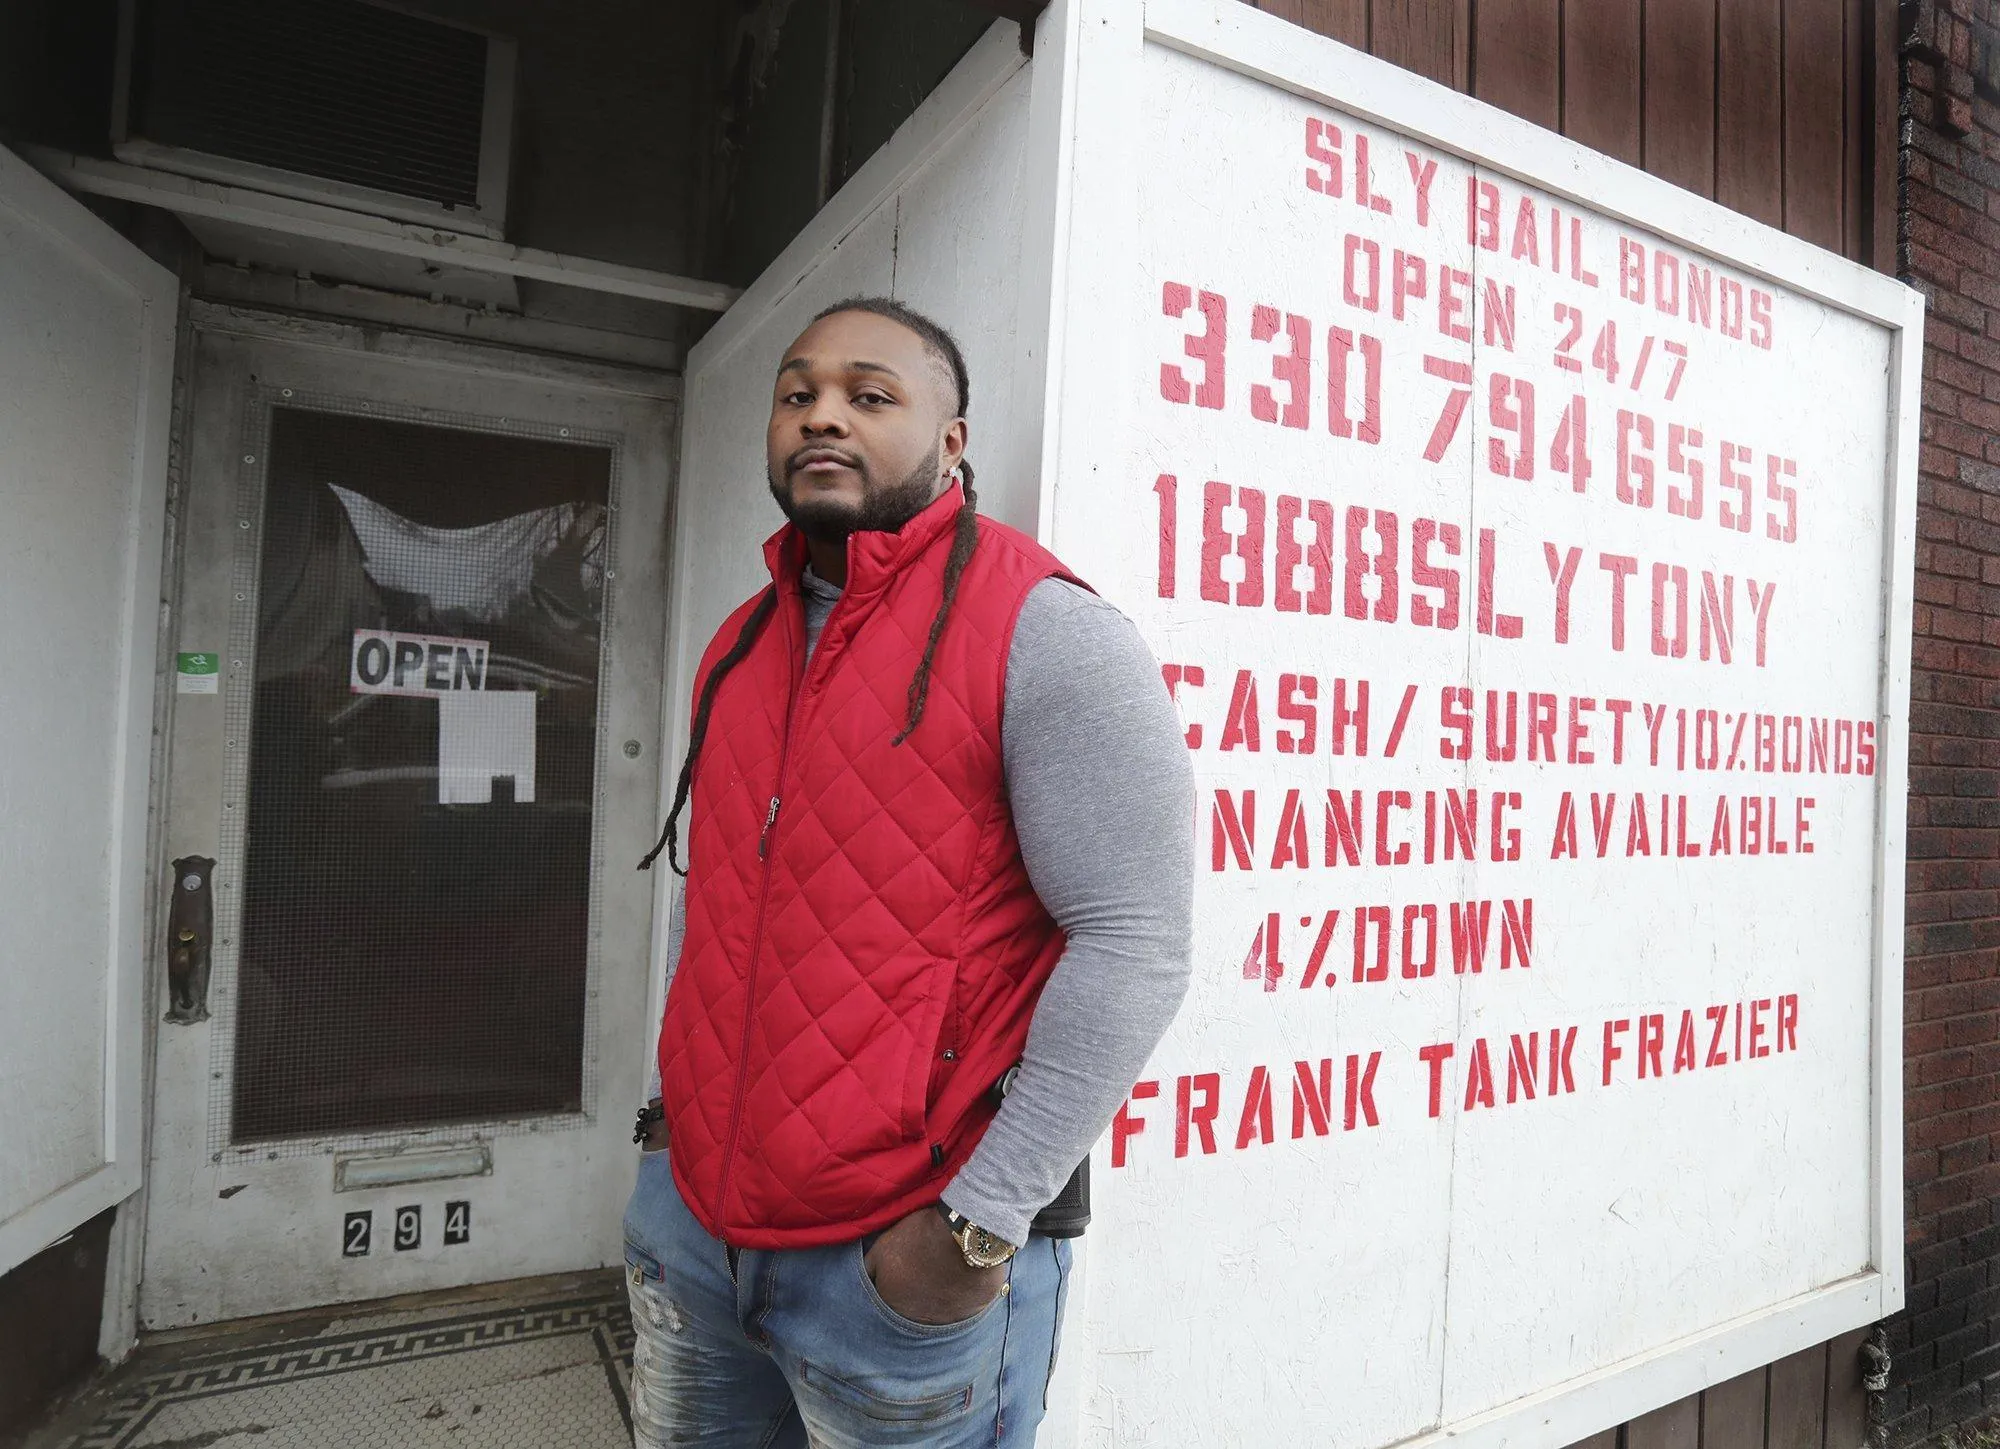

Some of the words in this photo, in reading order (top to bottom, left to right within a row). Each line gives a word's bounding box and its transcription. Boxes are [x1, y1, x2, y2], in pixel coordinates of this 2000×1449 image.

[1306, 117, 1437, 227] SLY
[1468, 175, 1598, 288] BAIL
[1620, 235, 1773, 351] BONDS
[1160, 281, 1382, 444] 330
[1343, 233, 1515, 352] OPEN
[1553, 302, 1689, 401] 24/7
[356, 637, 484, 691] OPEN
[1193, 788, 1522, 873] NANCING
[1551, 792, 1817, 861] AVAILABLE
[1111, 1050, 1382, 1168] FRANK
[1418, 1026, 1578, 1119] TANK
[1602, 993, 1799, 1087] FRAZIER
